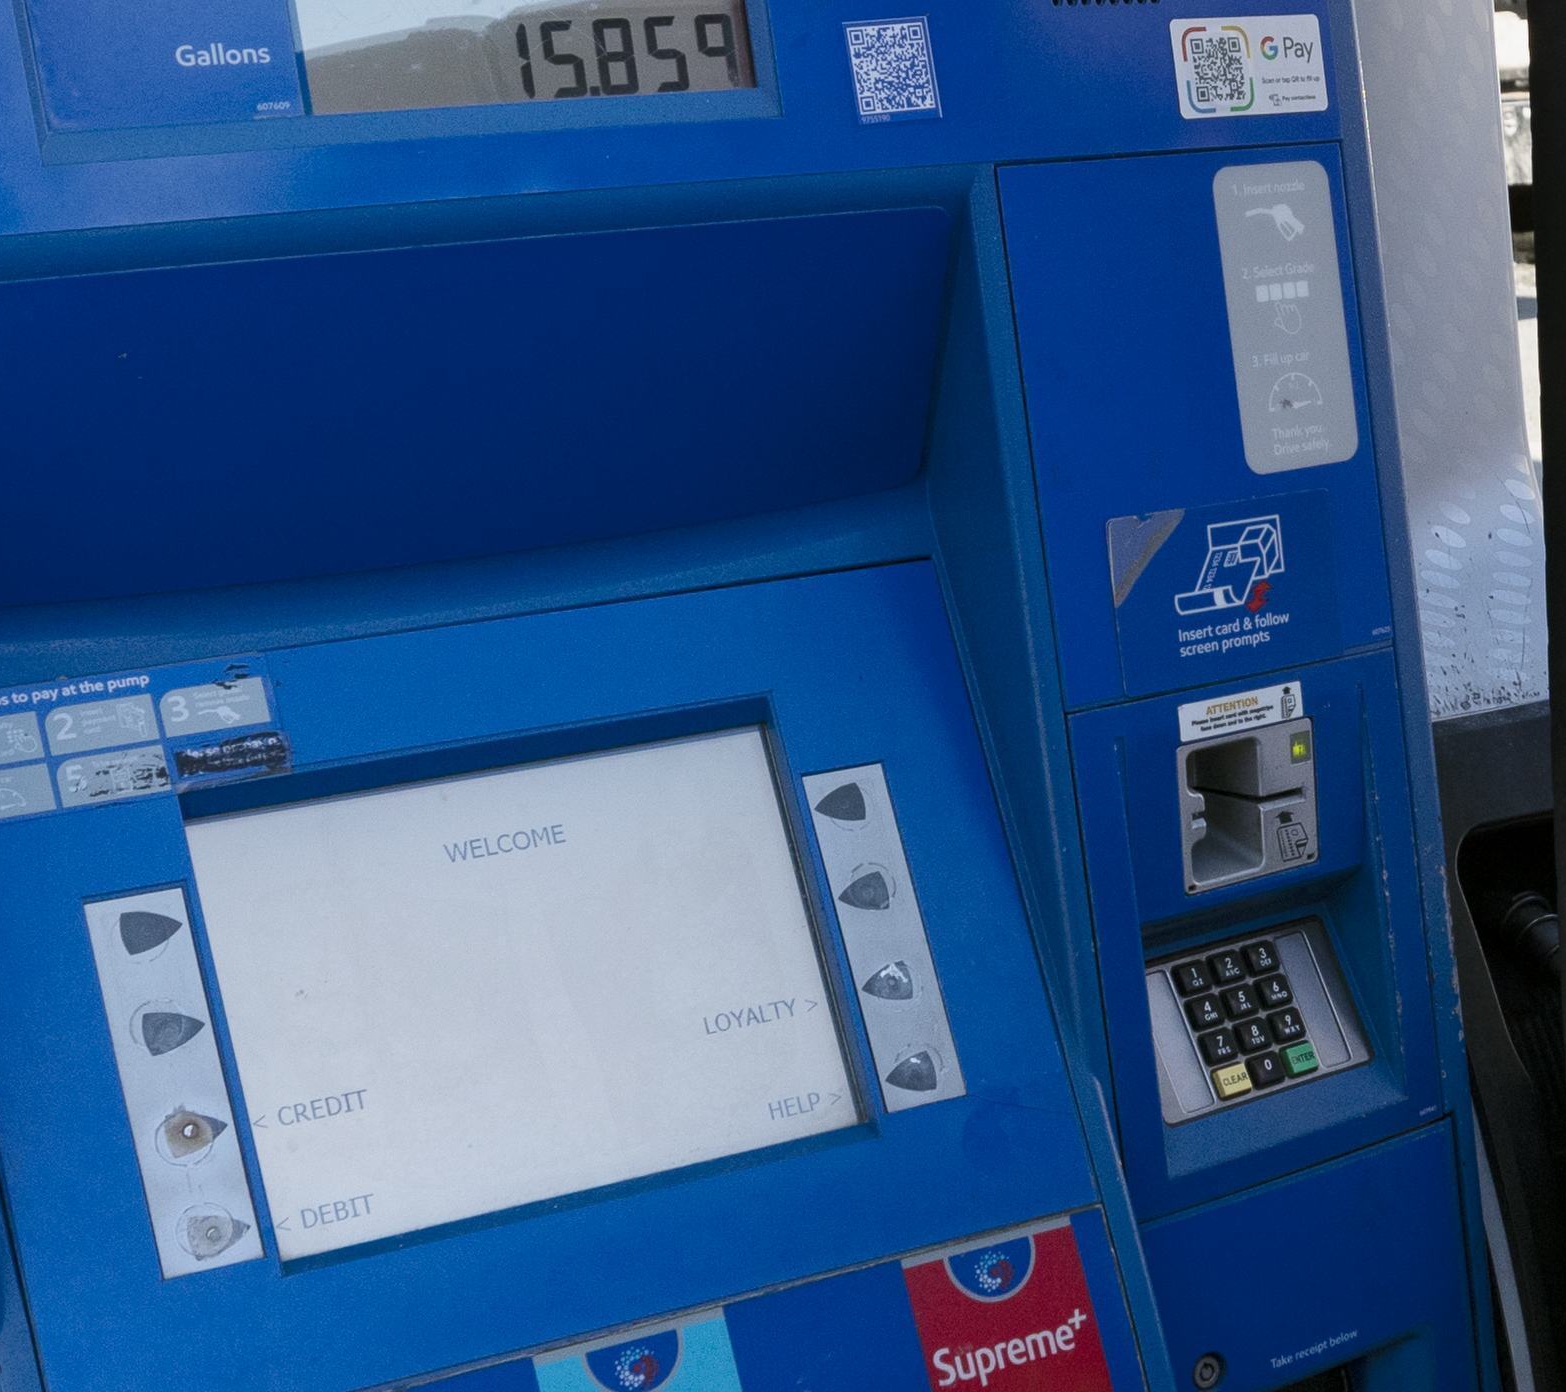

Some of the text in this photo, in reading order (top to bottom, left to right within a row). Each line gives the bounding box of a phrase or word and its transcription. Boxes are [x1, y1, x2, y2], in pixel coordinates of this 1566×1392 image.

[175, 41, 271, 67] Gallons
[515, 12, 738, 99] 15.859
[1260, 36, 1313, 63] G Pay
[256, 100, 291, 112] 607609
[1243, 179, 1306, 195] Insert nozzle
[1254, 260, 1315, 277] Select Grade
[1264, 351, 1310, 366] Fill up car
[1178, 611, 1289, 642] Insert card & follow
[1180, 630, 1270, 657] screen prompts
[12, 691, 28, 704] to
[32, 687, 57, 702] pay
[60, 684, 76, 697] at
[79, 680, 103, 694] the
[108, 675, 150, 692] pump
[1206, 696, 1258, 715] ATTENTION
[443, 823, 567, 865] WELCOME
[702, 998, 798, 1036] LOYALTY
[1223, 1051, 1316, 1086] CLEAR ENTER
[277, 1087, 367, 1128] CREDIT
[766, 1091, 822, 1122] HELP
[300, 1194, 375, 1230] DEBIT
[1269, 1329, 1358, 1370] Take receipt below
